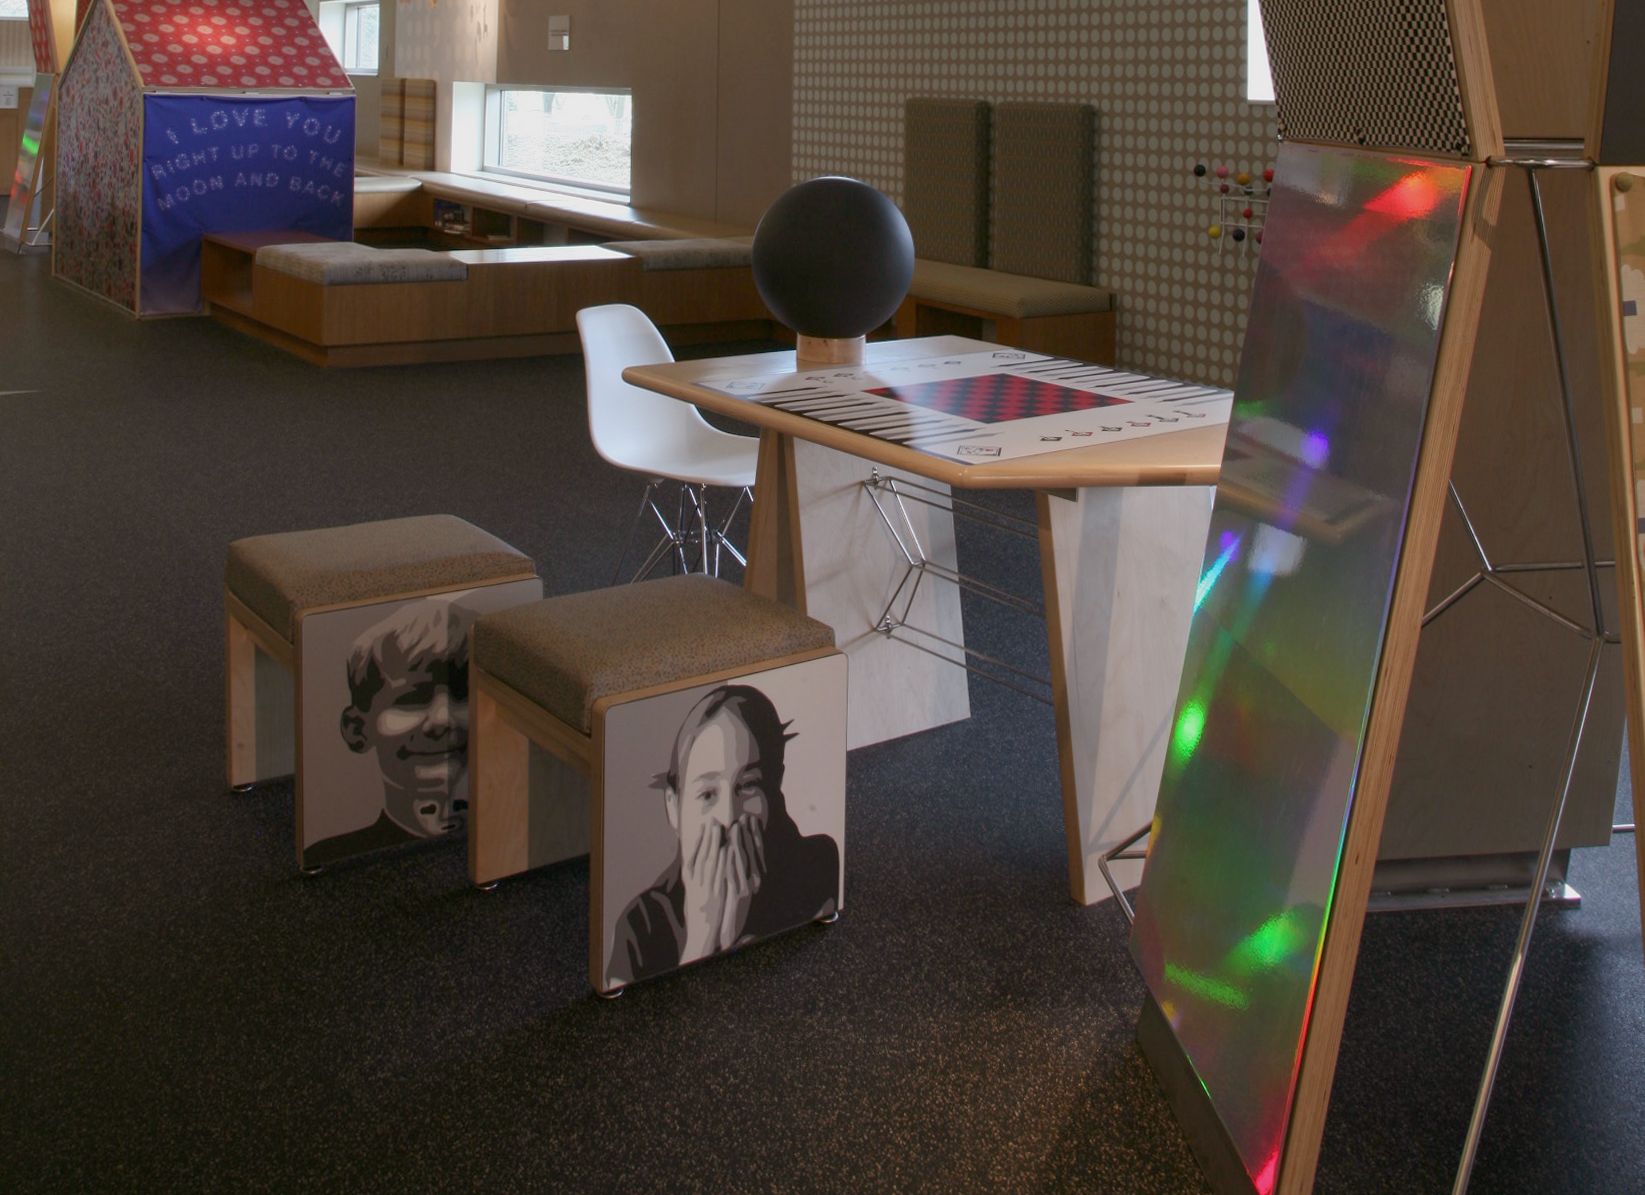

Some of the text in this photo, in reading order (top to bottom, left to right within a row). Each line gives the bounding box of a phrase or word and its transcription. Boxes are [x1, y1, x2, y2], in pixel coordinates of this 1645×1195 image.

[165, 108, 341, 145] I LOVE YOU
[151, 143, 346, 180] RIGHT UP TO THE
[157, 172, 345, 212] MOON AND BACK
